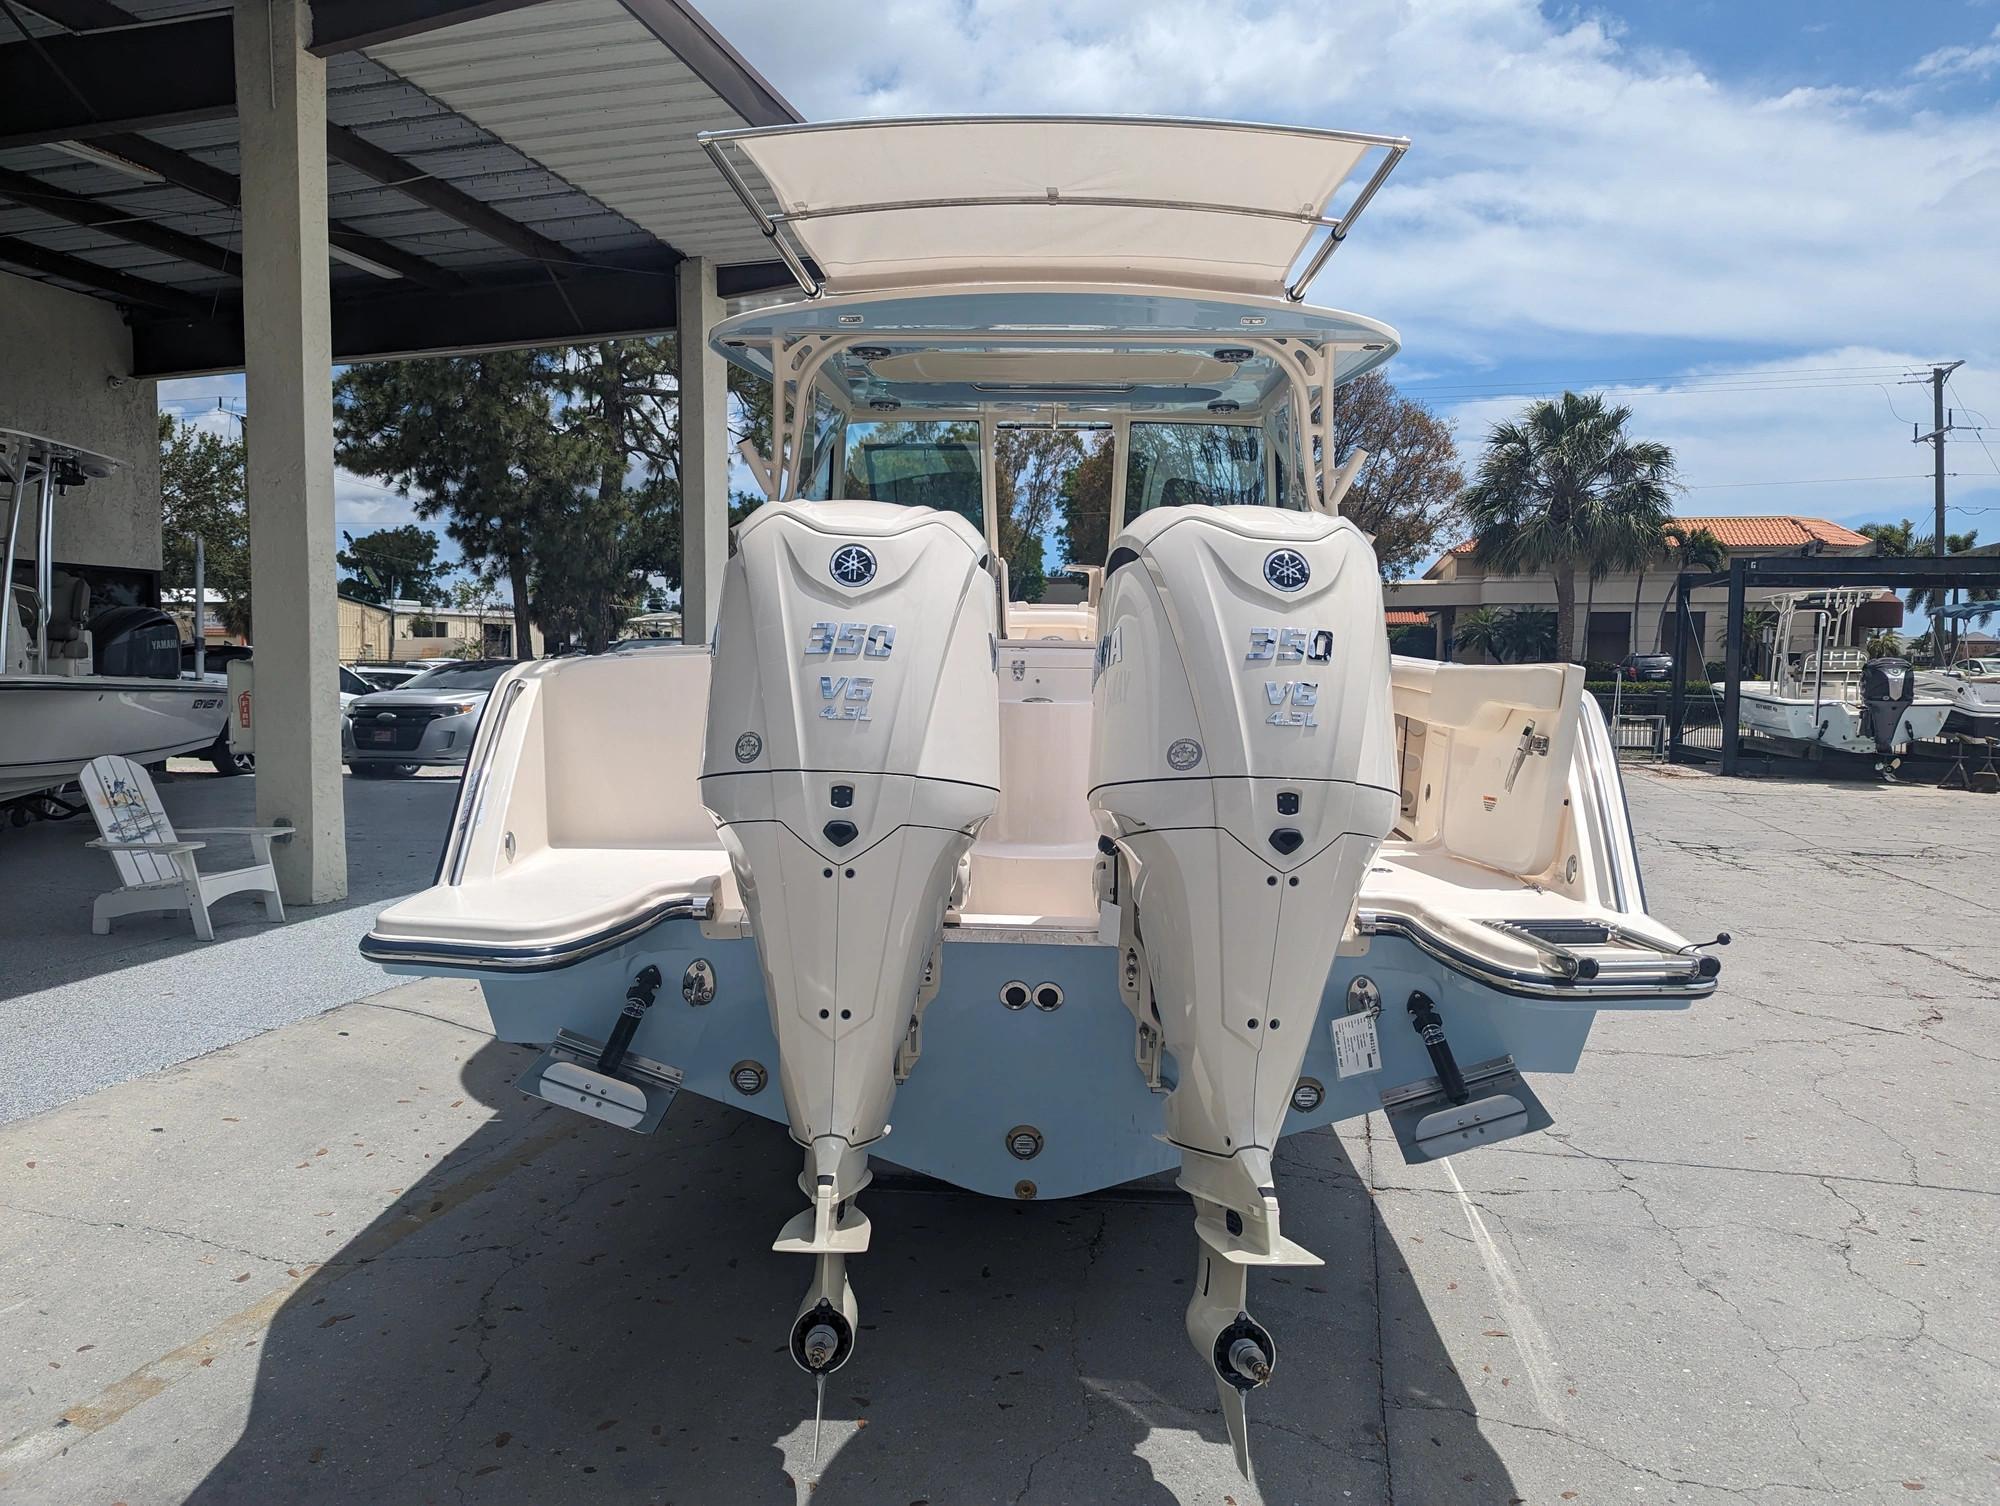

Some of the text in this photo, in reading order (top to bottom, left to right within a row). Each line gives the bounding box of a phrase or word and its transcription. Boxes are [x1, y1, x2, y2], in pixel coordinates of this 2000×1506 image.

[804, 622, 896, 658] 350
[1245, 627, 1334, 661] 350
[820, 676, 874, 701] V6
[1265, 681, 1318, 706] V6
